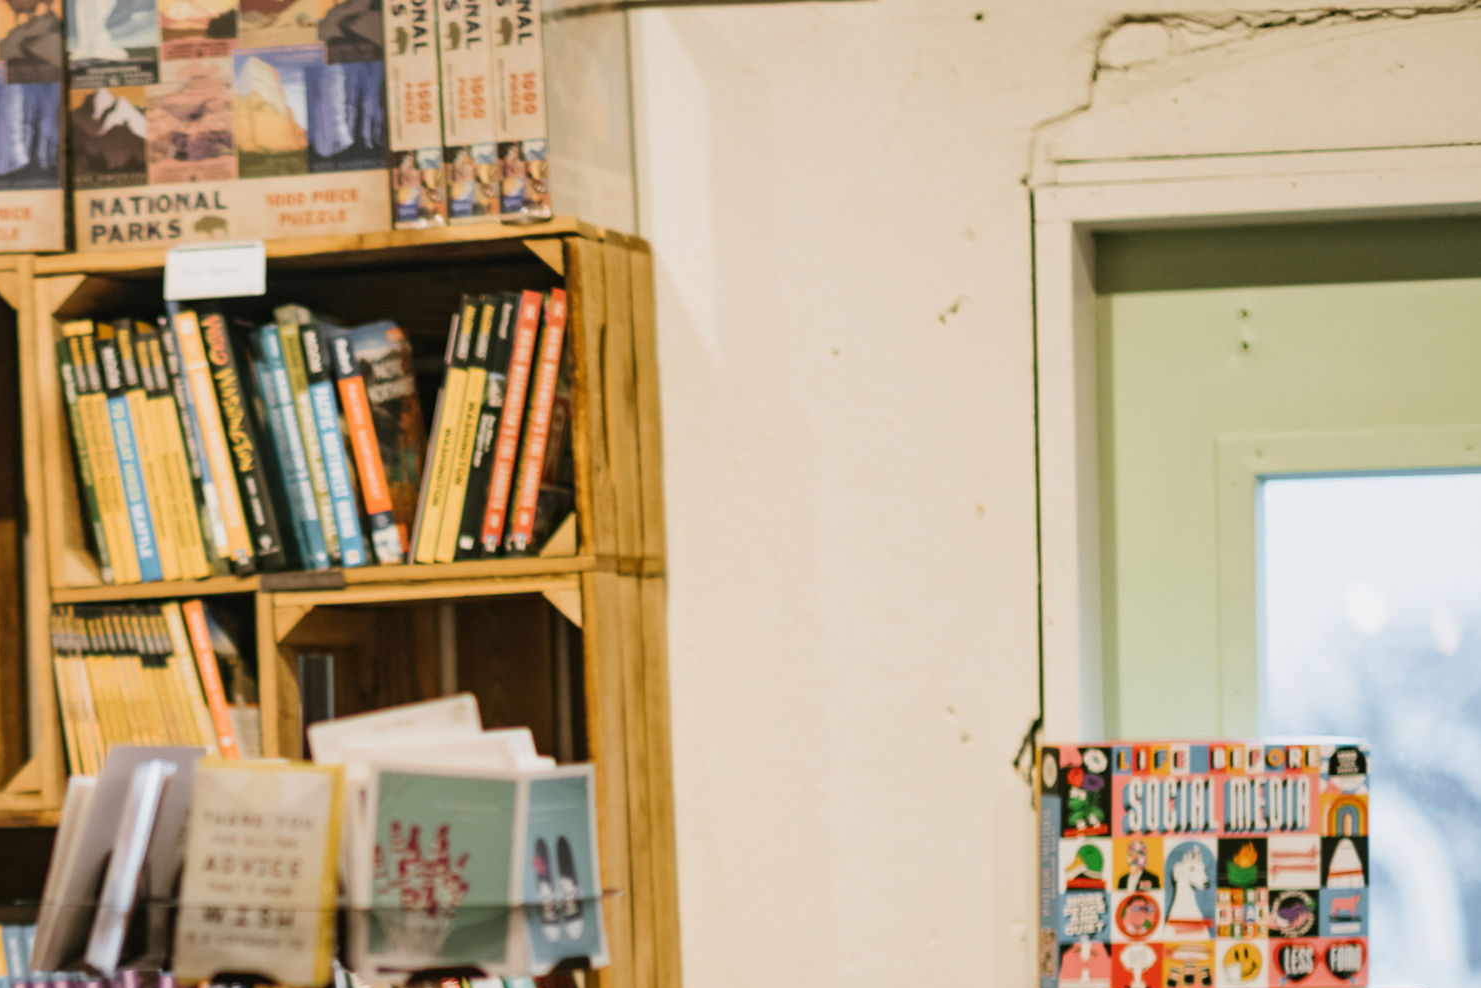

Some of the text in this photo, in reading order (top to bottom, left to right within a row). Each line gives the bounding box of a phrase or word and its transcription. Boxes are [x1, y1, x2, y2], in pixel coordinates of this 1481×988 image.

[521, 71, 538, 114] 1000
[90, 191, 227, 217] NATIONAL
[278, 208, 346, 226] PUZZLE
[90, 219, 182, 245] PARKS
[453, 401, 477, 486] WASHINGTON
[1118, 749, 1187, 771] LIFE
[1211, 746, 1318, 770] BEFORE
[1124, 775, 1310, 834] SOCIAL MEDIA
[203, 857, 301, 878] ADVICE
[203, 905, 295, 928] WISH
[1284, 946, 1315, 974] LESS
